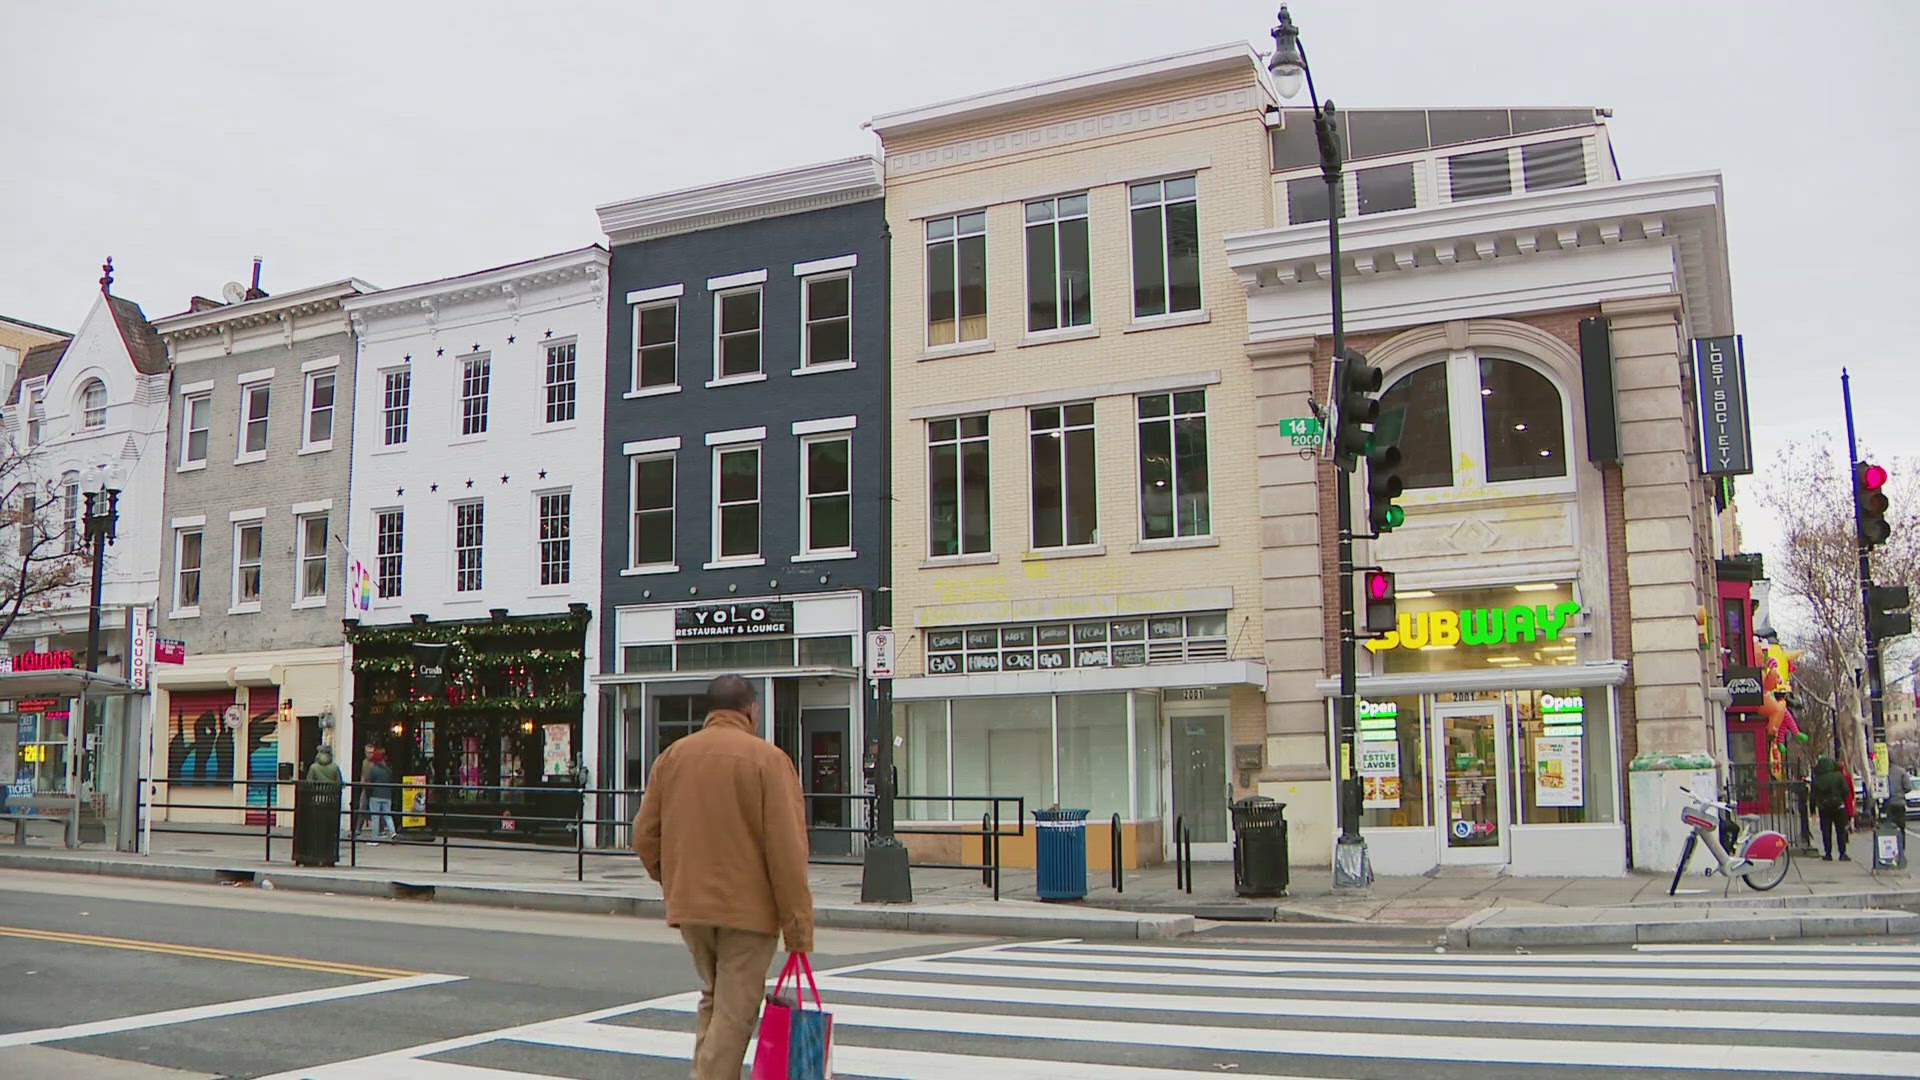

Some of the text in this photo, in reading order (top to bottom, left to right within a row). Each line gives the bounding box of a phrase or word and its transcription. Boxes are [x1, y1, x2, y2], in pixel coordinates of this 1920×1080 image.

[1710, 342, 1730, 469] LOST SOCIETY
[1289, 420, 1307, 435] 14
[1292, 435, 1321, 445] 2000
[695, 605, 766, 624] YOLO
[676, 623, 785, 637] RESTAURANT & LOUNGE
[133, 618, 144, 687] LIQUORS
[1006, 653, 1033, 668] OR
[1040, 652, 1062, 668] GO
[13, 650, 72, 671] LIQUORS
[420, 664, 442, 674] Crush
[1183, 689, 1203, 700] 2001
[1453, 691, 1475, 702] 2001
[1360, 700, 1397, 718] Open
[1541, 694, 1582, 712] Open
[1363, 753, 1396, 762] ESTIVE
[1363, 761, 1396, 769] AVORS
